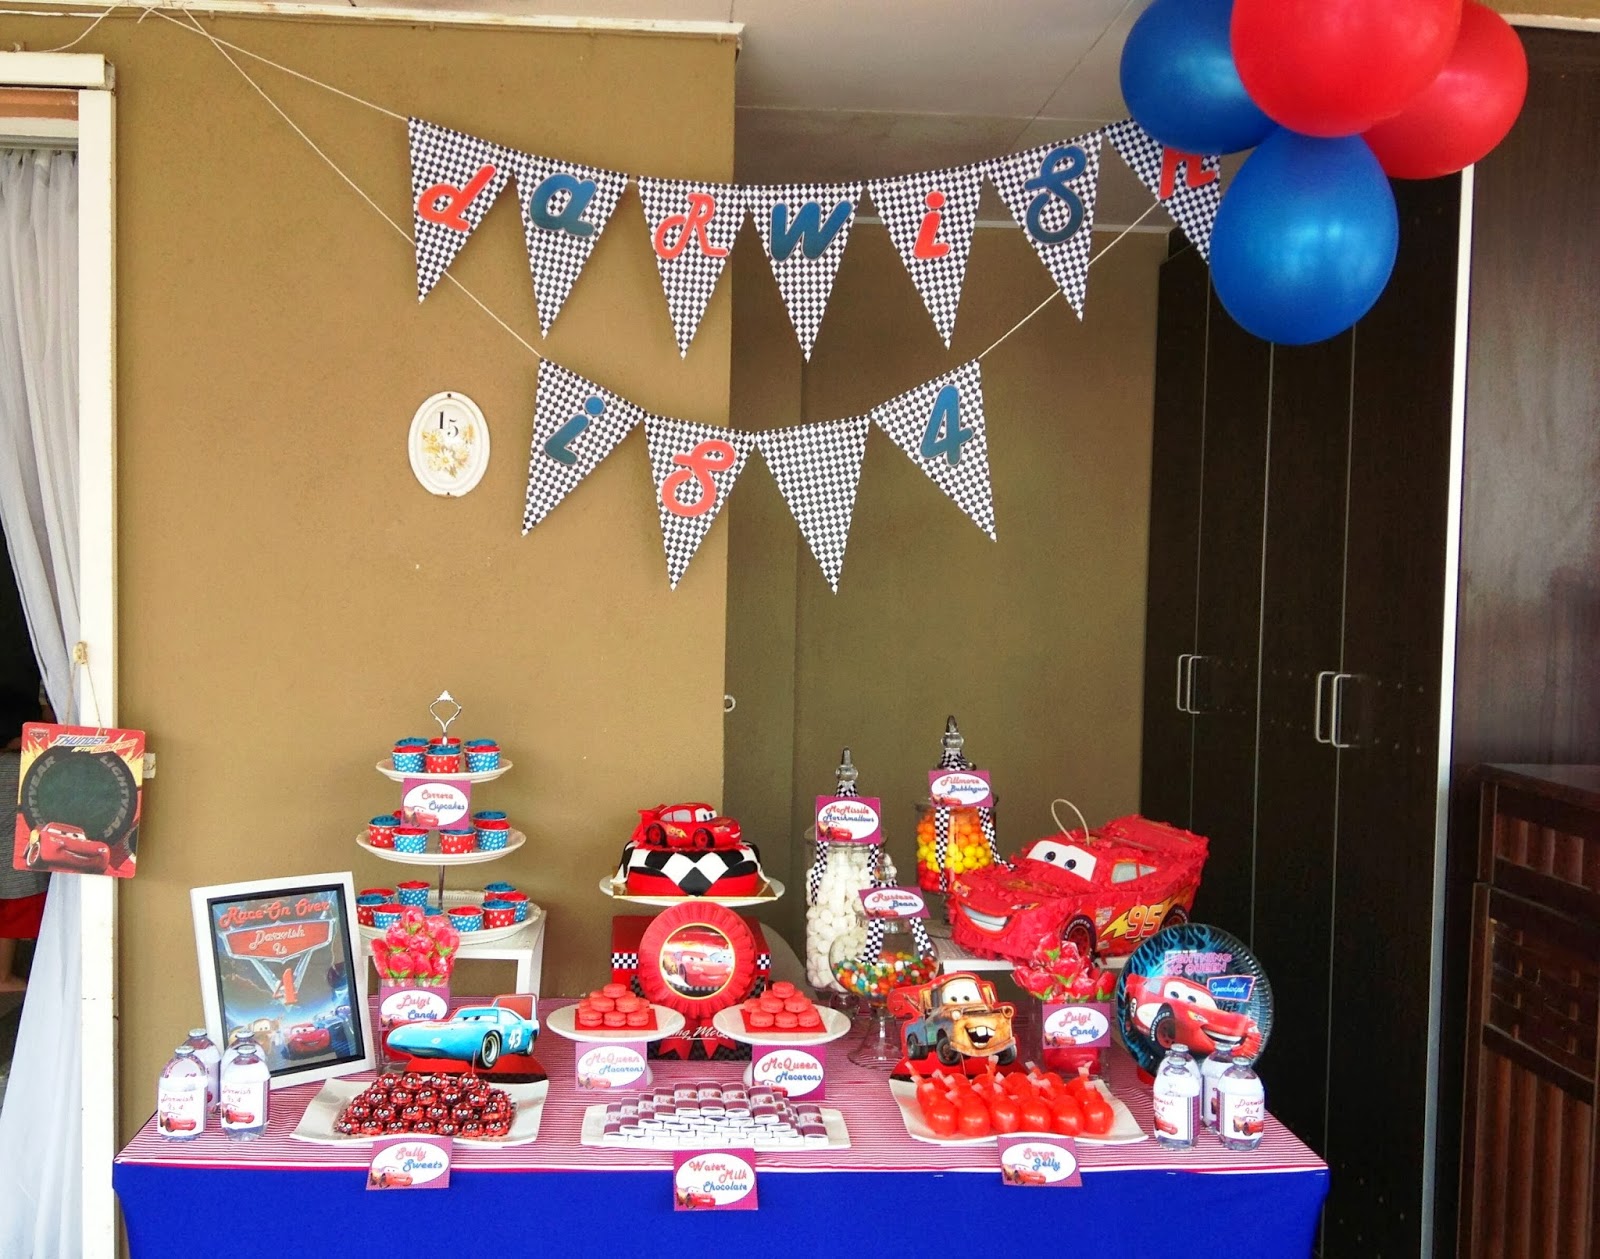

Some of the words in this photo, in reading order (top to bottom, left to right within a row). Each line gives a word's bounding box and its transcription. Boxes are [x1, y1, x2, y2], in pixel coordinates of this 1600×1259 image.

[439, 411, 459, 438] 15
[920, 385, 974, 466] 4
[888, 900, 918, 909] Beans
[1125, 904, 1164, 939] 95
[248, 924, 306, 950] Darwish
[272, 968, 298, 1005] 4
[396, 994, 431, 1010] Luigi
[407, 1009, 438, 1019] Candy
[1058, 1011, 1092, 1027] Luigi
[508, 1029, 522, 1049] 43
[1070, 1026, 1099, 1038] Candy
[585, 1052, 640, 1066] McQueen
[762, 1057, 818, 1072] McQueen
[599, 1064, 643, 1075] Macarons
[775, 1071, 821, 1083] Macarons
[395, 1146, 427, 1161] Sally
[402, 1159, 443, 1172] Sweets
[688, 1160, 726, 1171] Water
[1032, 1157, 1061, 1172] Jelly
[718, 1169, 747, 1183] Milk
[703, 1181, 748, 1193] Chocolate
